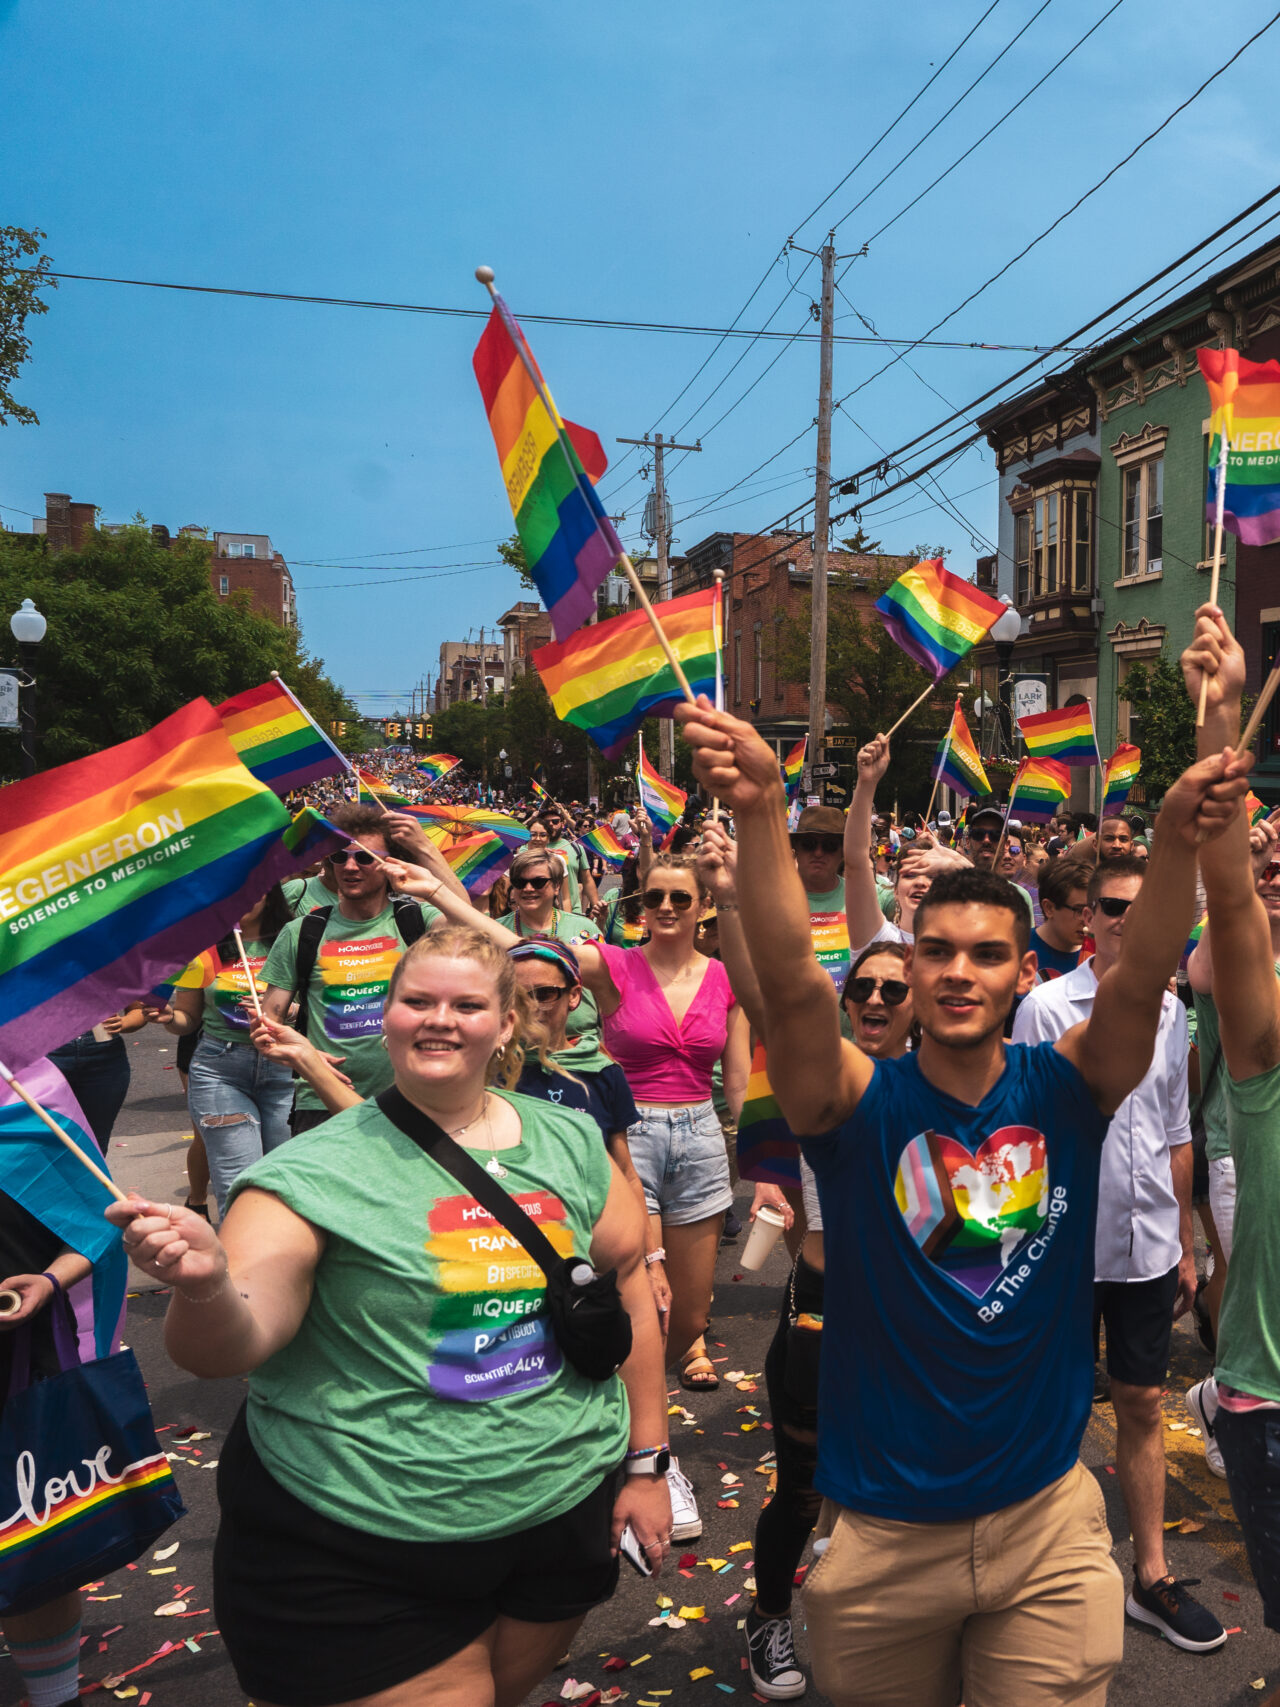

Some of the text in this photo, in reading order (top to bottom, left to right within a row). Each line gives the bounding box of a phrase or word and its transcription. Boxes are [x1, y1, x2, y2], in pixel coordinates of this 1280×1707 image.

[1230, 456, 1243, 466] TO
[0, 808, 186, 922] EGENERON
[9, 890, 81, 935] SCIENCE
[83, 876, 107, 896] TO
[977, 1186, 1068, 1323] Be The Change
[464, 1356, 545, 1384] SCIENTIFICALLY
[16, 1445, 122, 1527] love
